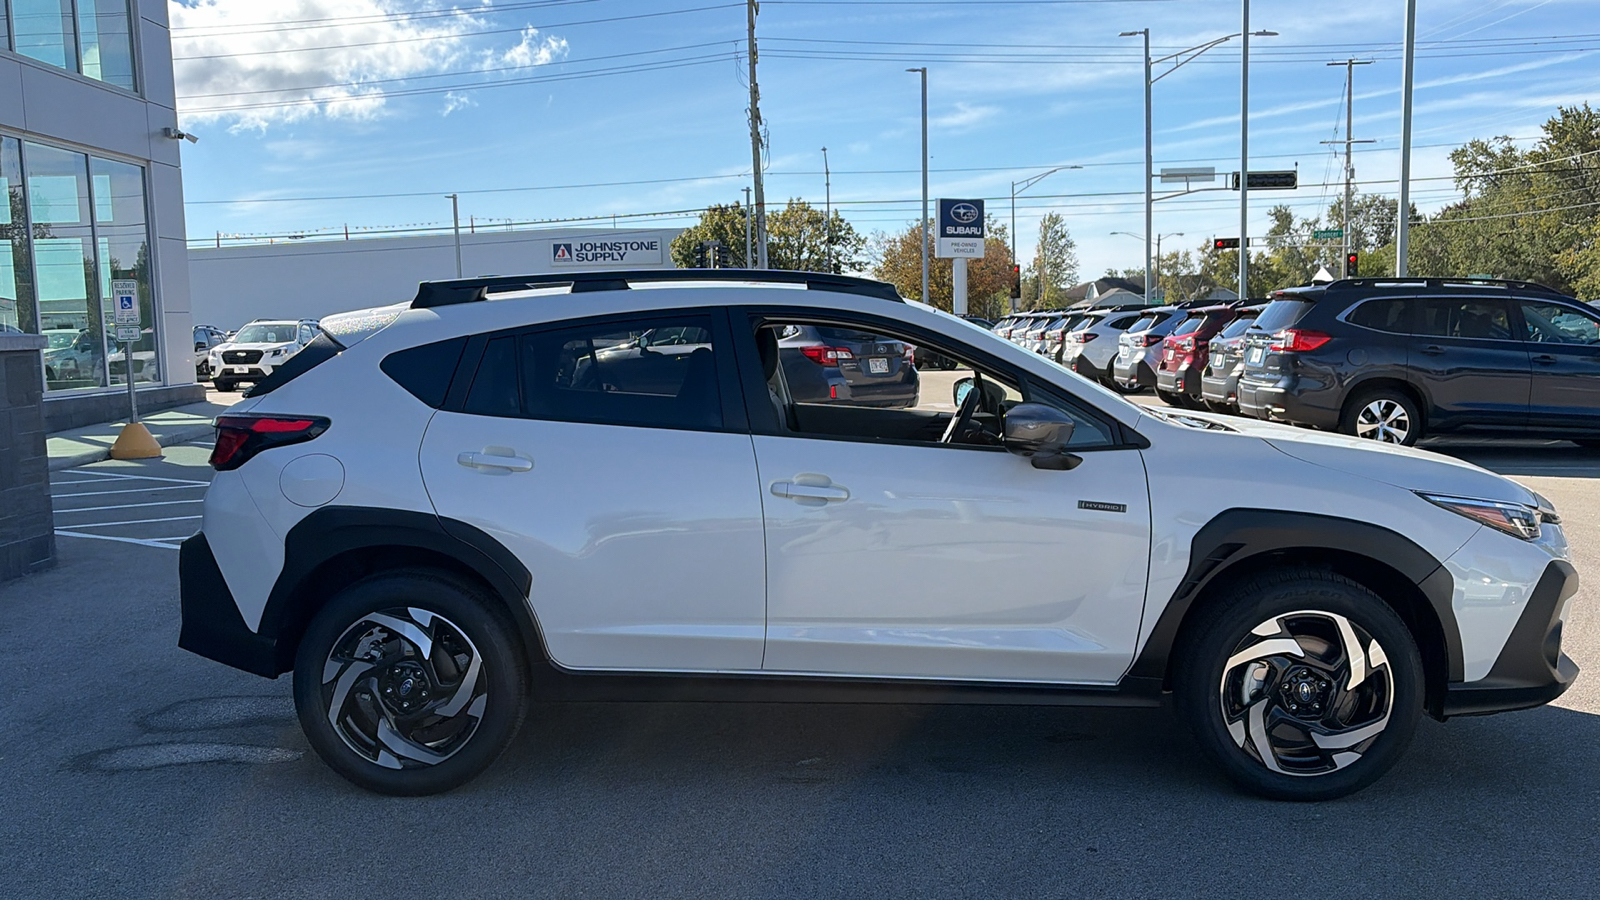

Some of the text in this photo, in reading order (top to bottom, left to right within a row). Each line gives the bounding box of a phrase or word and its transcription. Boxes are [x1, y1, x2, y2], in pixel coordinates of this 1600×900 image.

[946, 226, 982, 235] SUBARU
[575, 240, 658, 252] JOHNSTONE
[576, 252, 627, 262] SUPPLY
[1085, 502, 1119, 511] HYBRID
